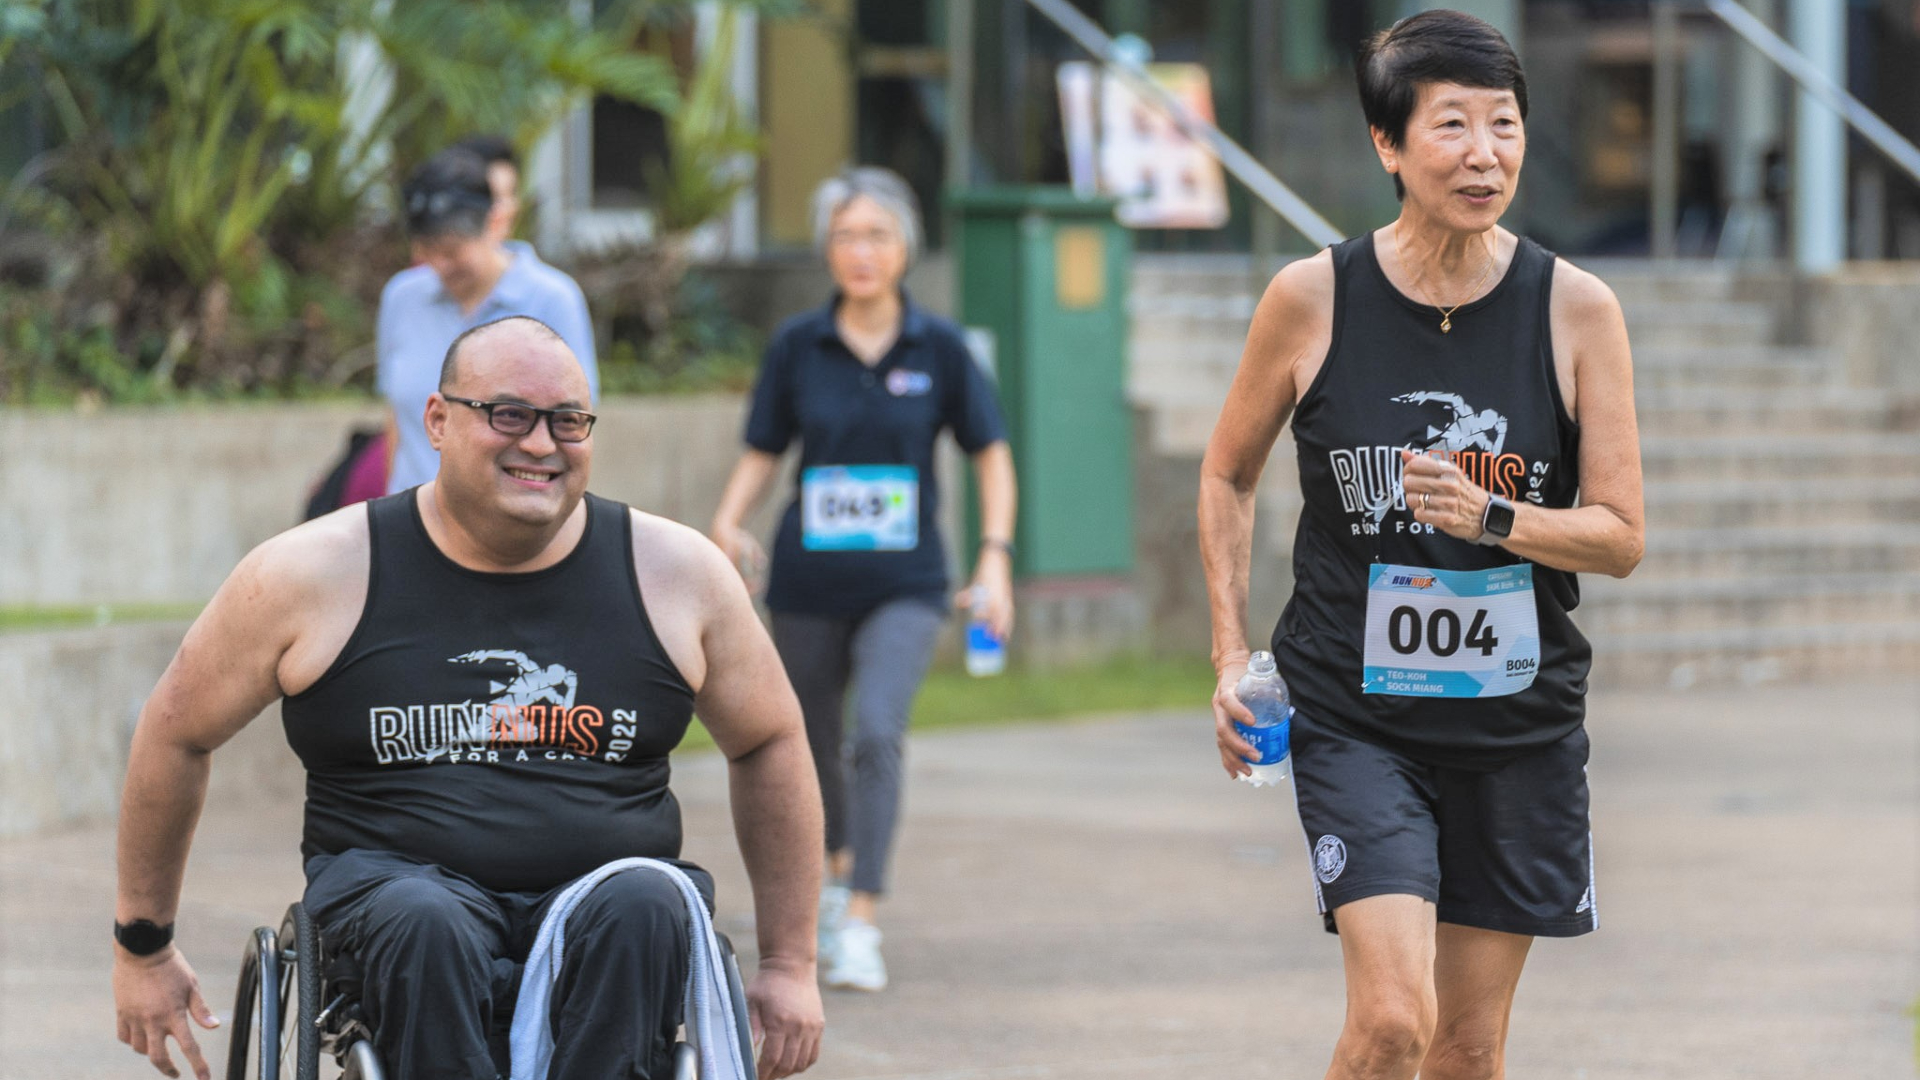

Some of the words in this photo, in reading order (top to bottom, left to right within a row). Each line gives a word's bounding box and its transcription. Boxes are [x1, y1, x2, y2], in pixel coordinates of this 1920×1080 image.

[1396, 521, 1435, 535] FOR
[1388, 605, 1498, 657] 004
[1506, 658, 1535, 671] B004
[1387, 670, 1427, 681] TEO-KOH
[1386, 682, 1411, 692] SOCK
[1413, 684, 1444, 693] MIANG
[605, 708, 637, 763] 2022
[450, 750, 499, 763] FOR
[516, 750, 529, 762] A
